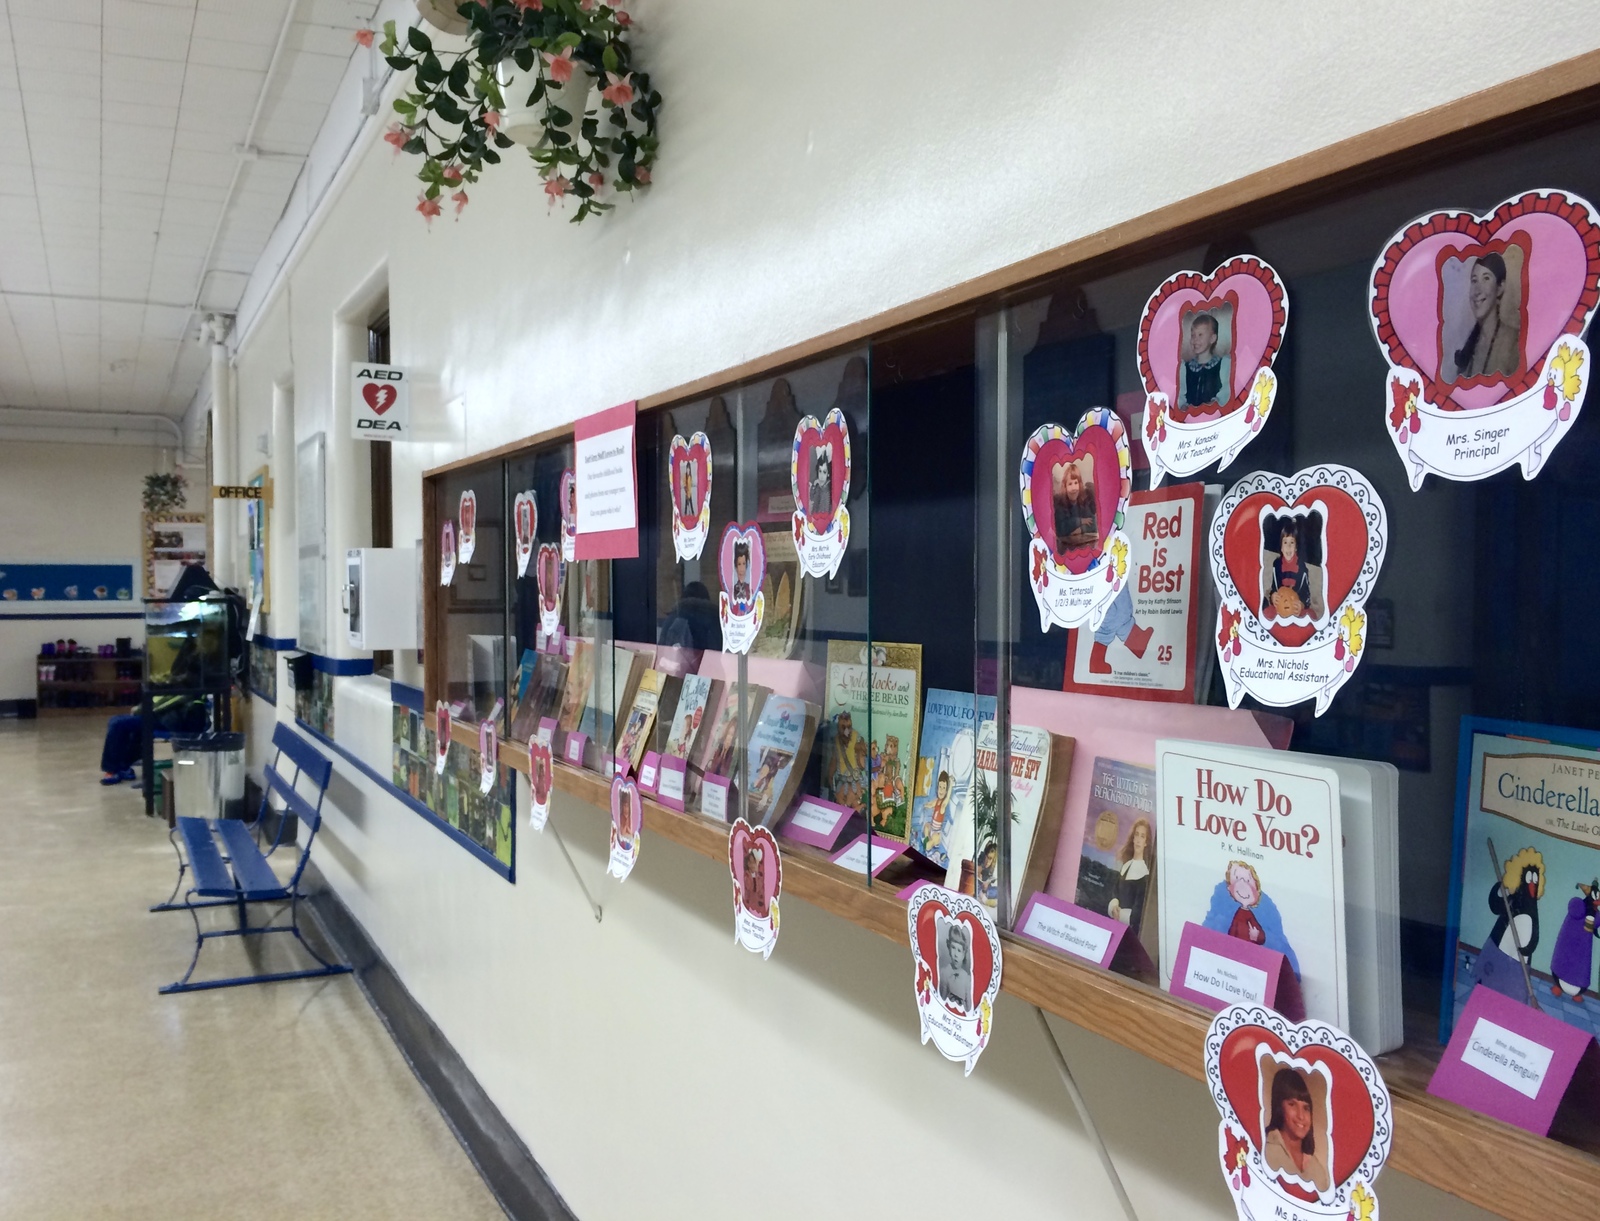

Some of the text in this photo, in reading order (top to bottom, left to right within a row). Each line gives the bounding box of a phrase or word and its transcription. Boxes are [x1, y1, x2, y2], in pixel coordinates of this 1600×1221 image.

[356, 368, 403, 381] AED
[356, 418, 401, 431] DEA
[1446, 427, 1510, 446] Mrs. Singer
[1454, 442, 1500, 460] Principal
[219, 486, 262, 498] OFFICE
[1143, 505, 1183, 540] Red
[1153, 540, 1168, 568] is
[1138, 563, 1185, 593] Best
[1157, 645, 1172, 662] 25
[1257, 658, 1309, 671] Mrs. Nichols
[1240, 667, 1329, 683] Educational Assistant
[897, 682, 910, 692] and
[882, 692, 909, 706] BEARS
[928, 702, 944, 716] LOVE
[944, 704, 959, 718] YOU
[1024, 758, 1042, 780] SPY
[1552, 763, 1600, 780] JANET PE
[1102, 772, 1115, 787] THE
[1196, 768, 1249, 806] How
[1254, 779, 1292, 816] Do
[1498, 772, 1600, 817] Cinderella
[1176, 796, 1320, 858] I Love You?
[1221, 842, 1264, 860] P. K. Hallinan
[1037, 921, 1046, 931] The
[1047, 926, 1060, 936] Witch
[1065, 933, 1085, 947] Blackbird
[1085, 940, 1098, 951] Pond
[1193, 970, 1210, 984] How
[1211, 976, 1221, 988] Do
[1221, 980, 1225, 989] I
[1226, 982, 1241, 996] Love
[928, 1013, 974, 1050] Educational Assistant
[1472, 1041, 1540, 1083] Cinderella Penguin
